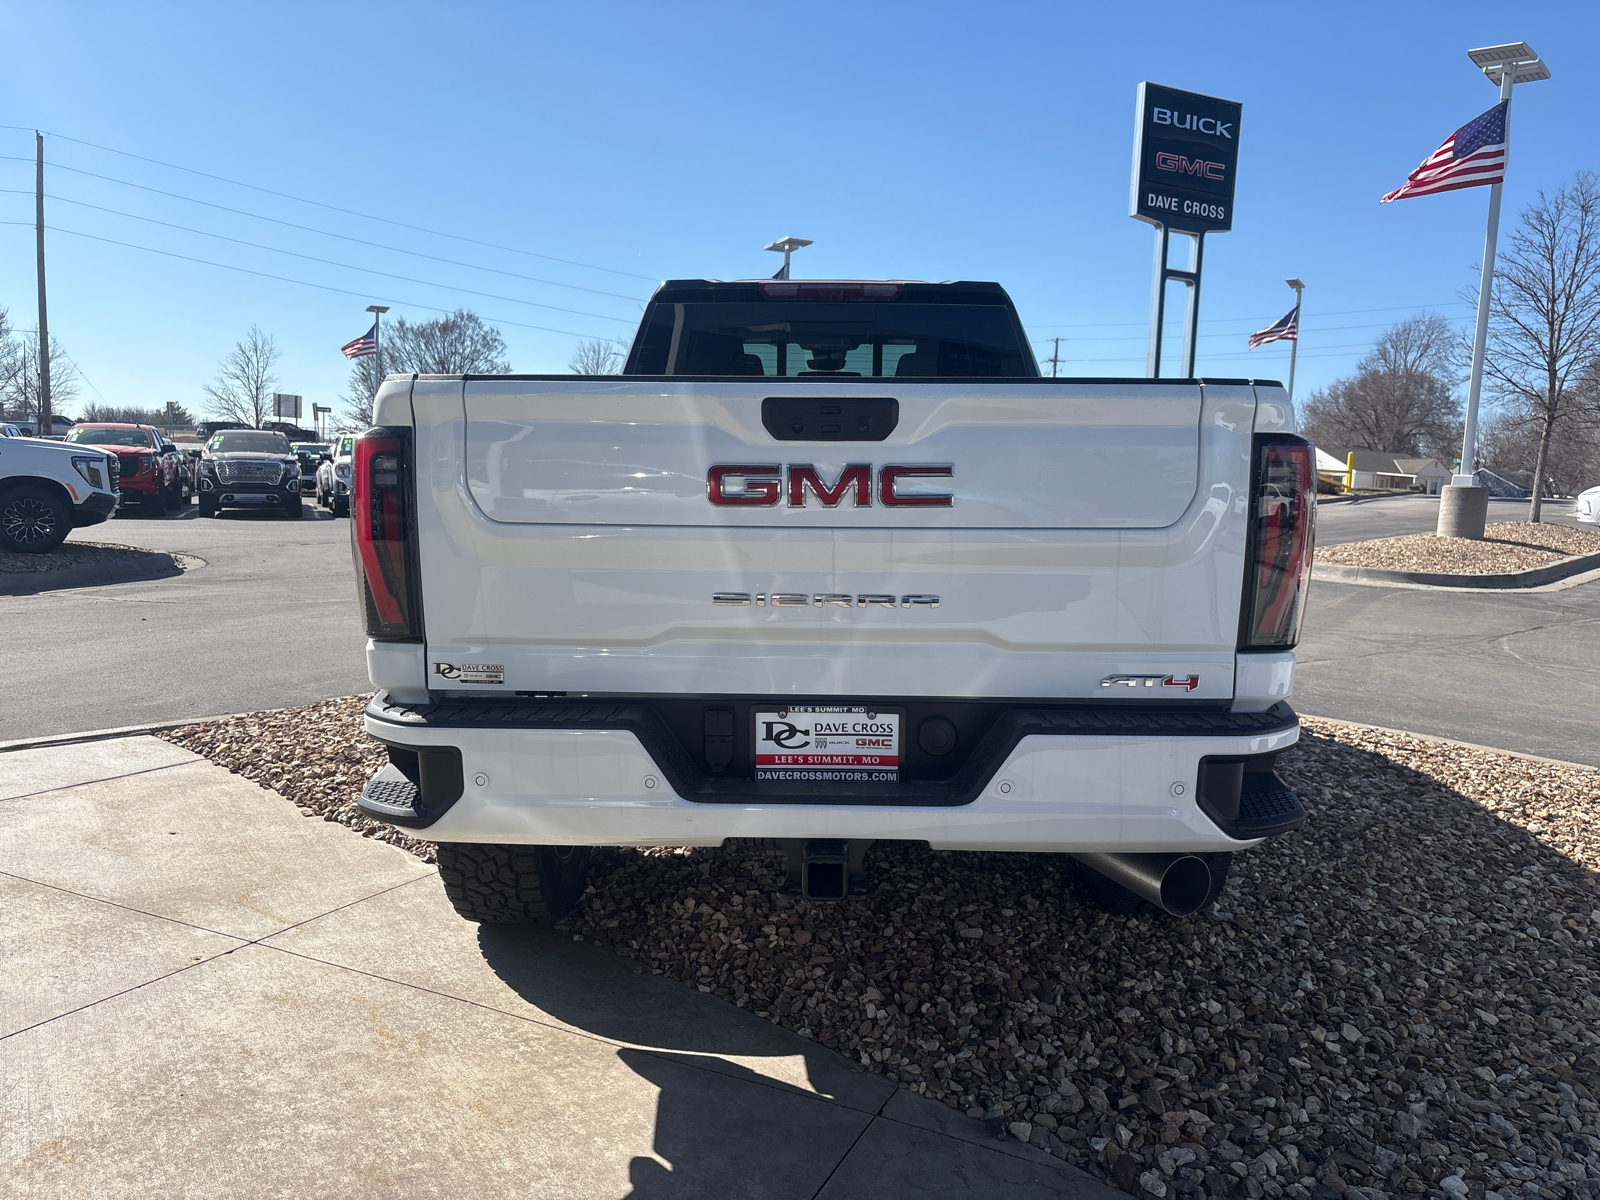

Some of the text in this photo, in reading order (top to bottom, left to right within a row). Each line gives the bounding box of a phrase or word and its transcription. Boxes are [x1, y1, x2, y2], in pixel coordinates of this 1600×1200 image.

[1152, 107, 1233, 139] BUICK
[1156, 151, 1225, 181] GMC
[1148, 193, 1225, 220] DAVE CROSS
[706, 462, 955, 509] GMC
[711, 592, 941, 609] SIERRA
[1100, 673, 1200, 692] AT4
[814, 722, 893, 734] DAVE CROSS
[855, 738, 893, 747] GMC
[774, 755, 880, 765] LEE'S SUMMIT, MO
[757, 771, 897, 782] DAVECROSSMOTORS.COM
